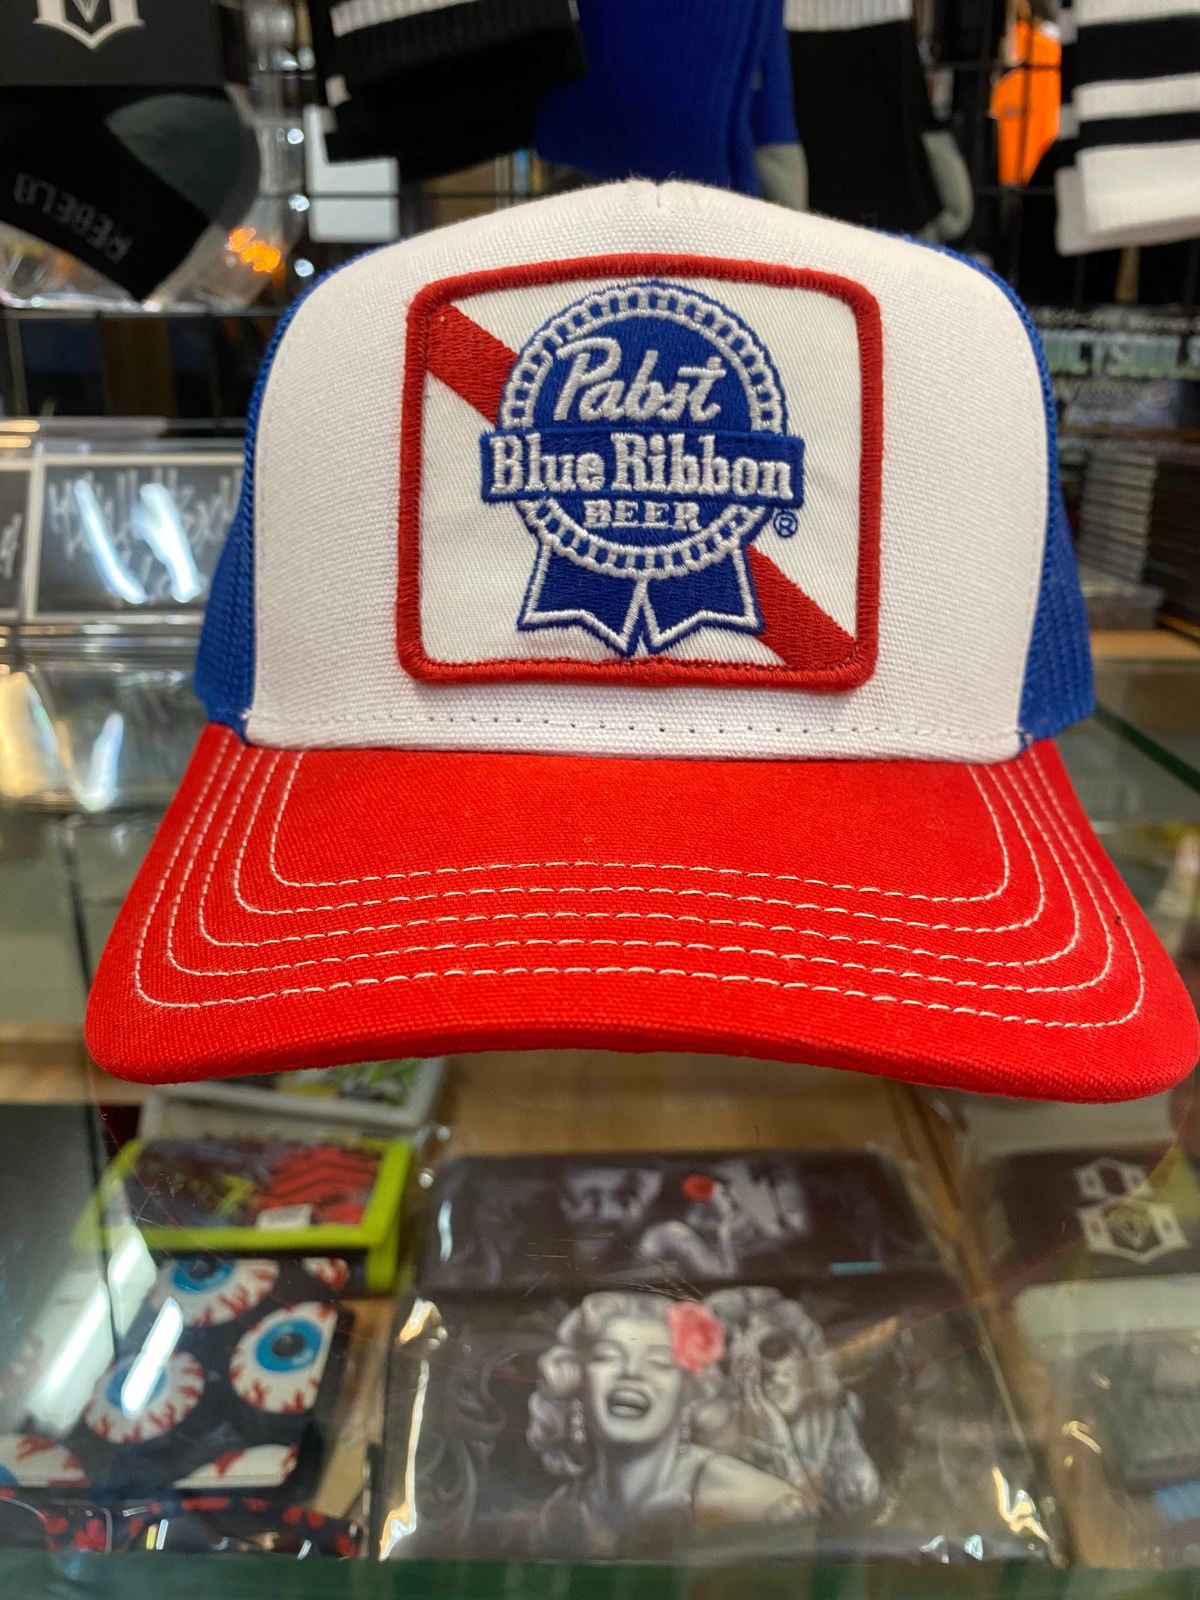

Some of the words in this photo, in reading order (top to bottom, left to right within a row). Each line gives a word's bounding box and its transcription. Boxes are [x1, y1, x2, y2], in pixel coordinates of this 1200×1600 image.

[553, 337, 727, 422] Pabst
[489, 433, 606, 495] Blue
[611, 432, 794, 500] Ribbon
[583, 499, 701, 531] BEER
